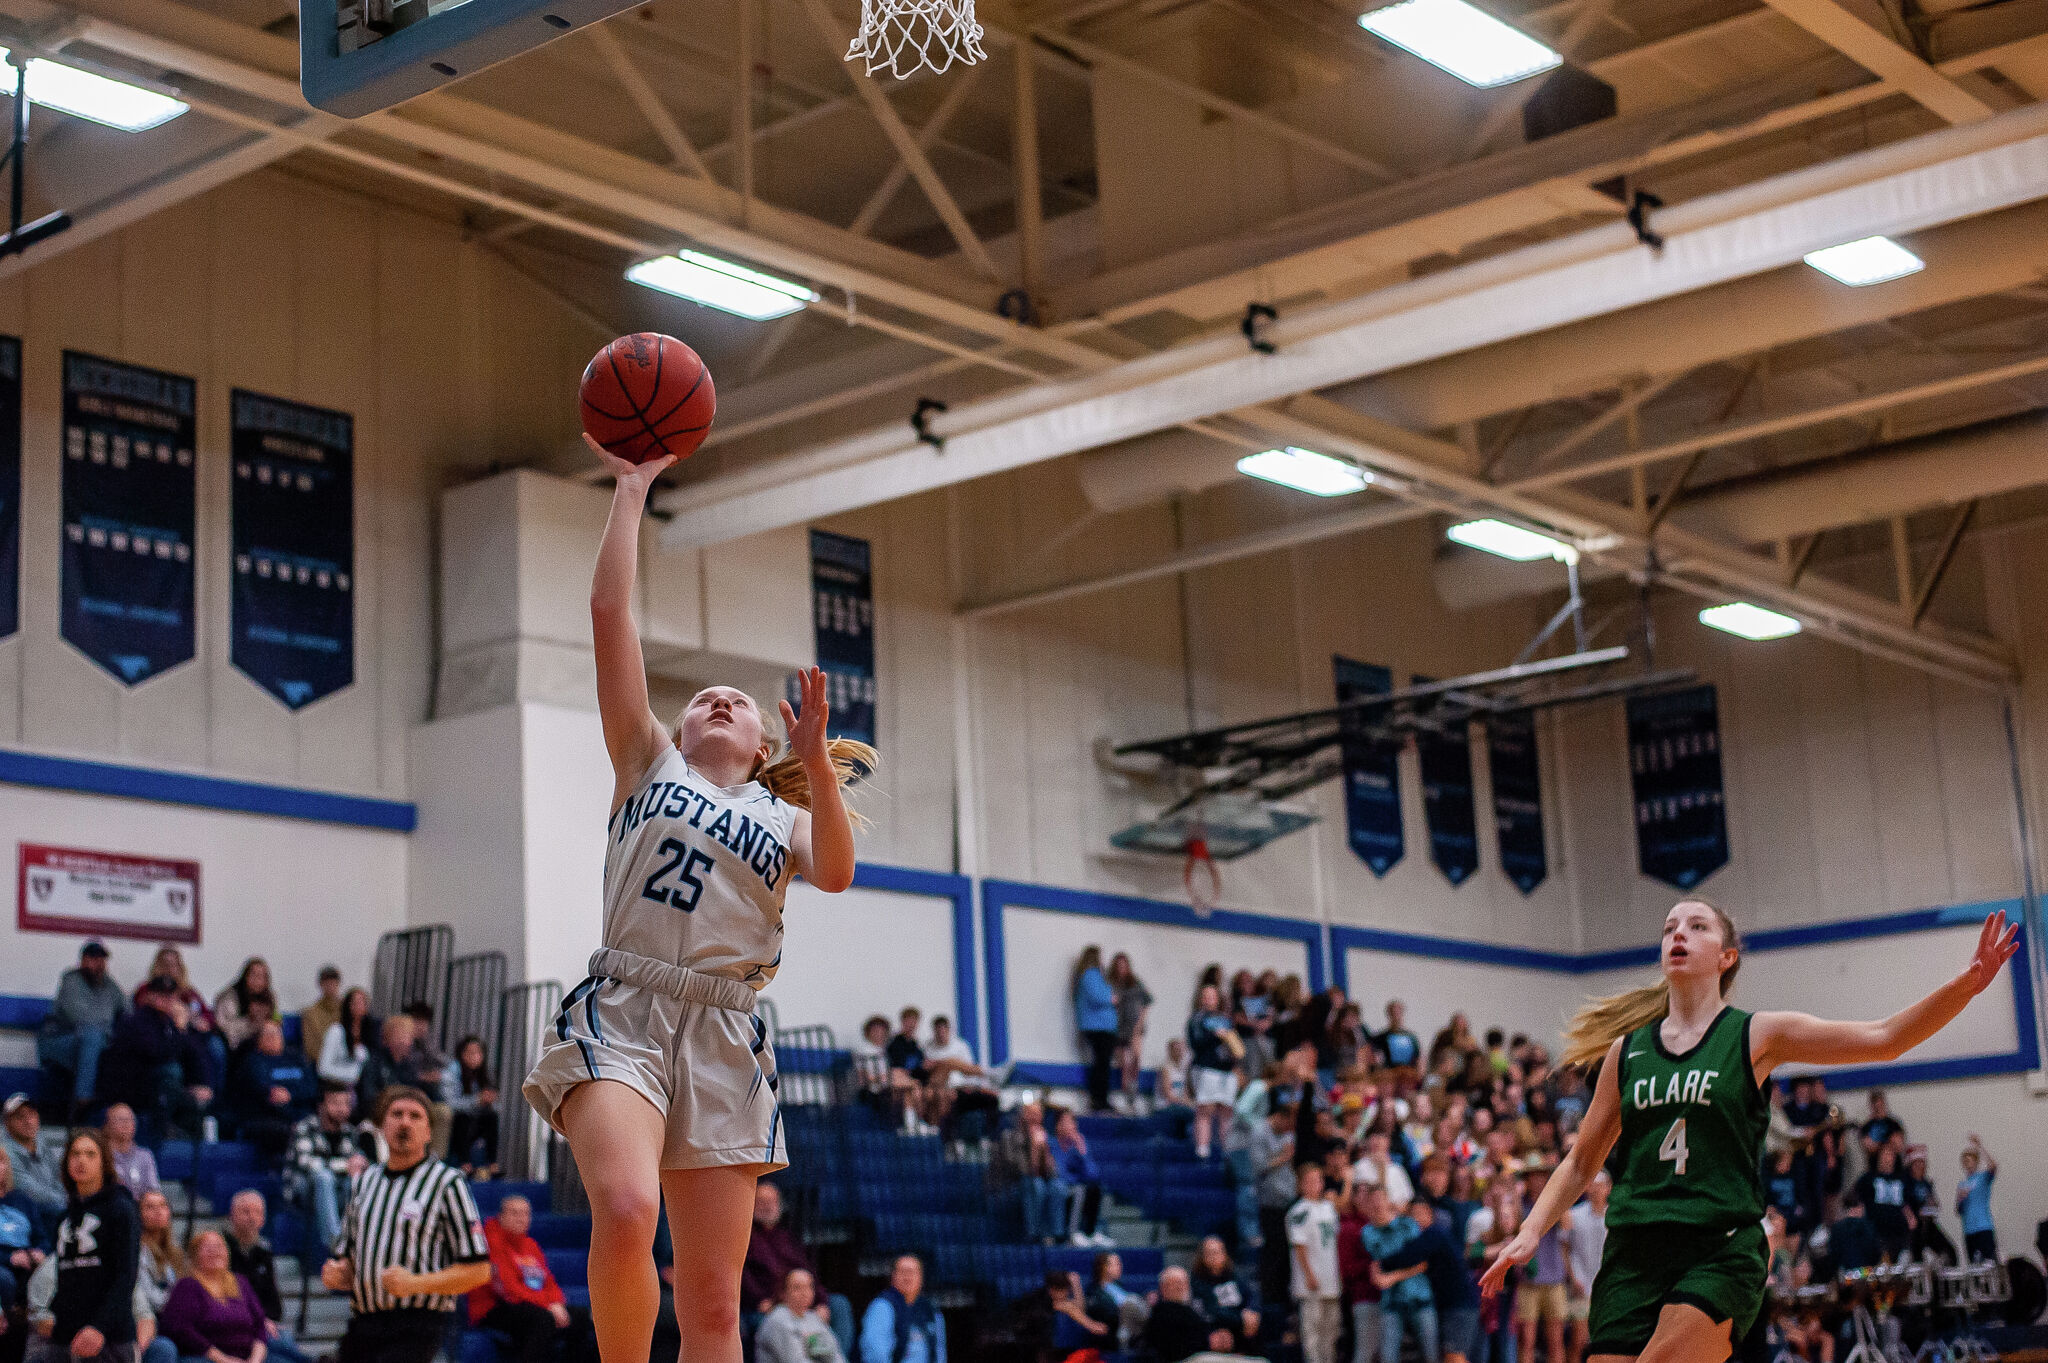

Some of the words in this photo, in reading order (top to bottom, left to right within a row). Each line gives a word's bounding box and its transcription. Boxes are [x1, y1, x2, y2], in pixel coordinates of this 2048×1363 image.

[617, 782, 786, 891] MUSTANGS
[642, 837, 715, 913] 25
[1634, 1070, 1719, 1110] CLARE
[1659, 1117, 1689, 1175] 4
